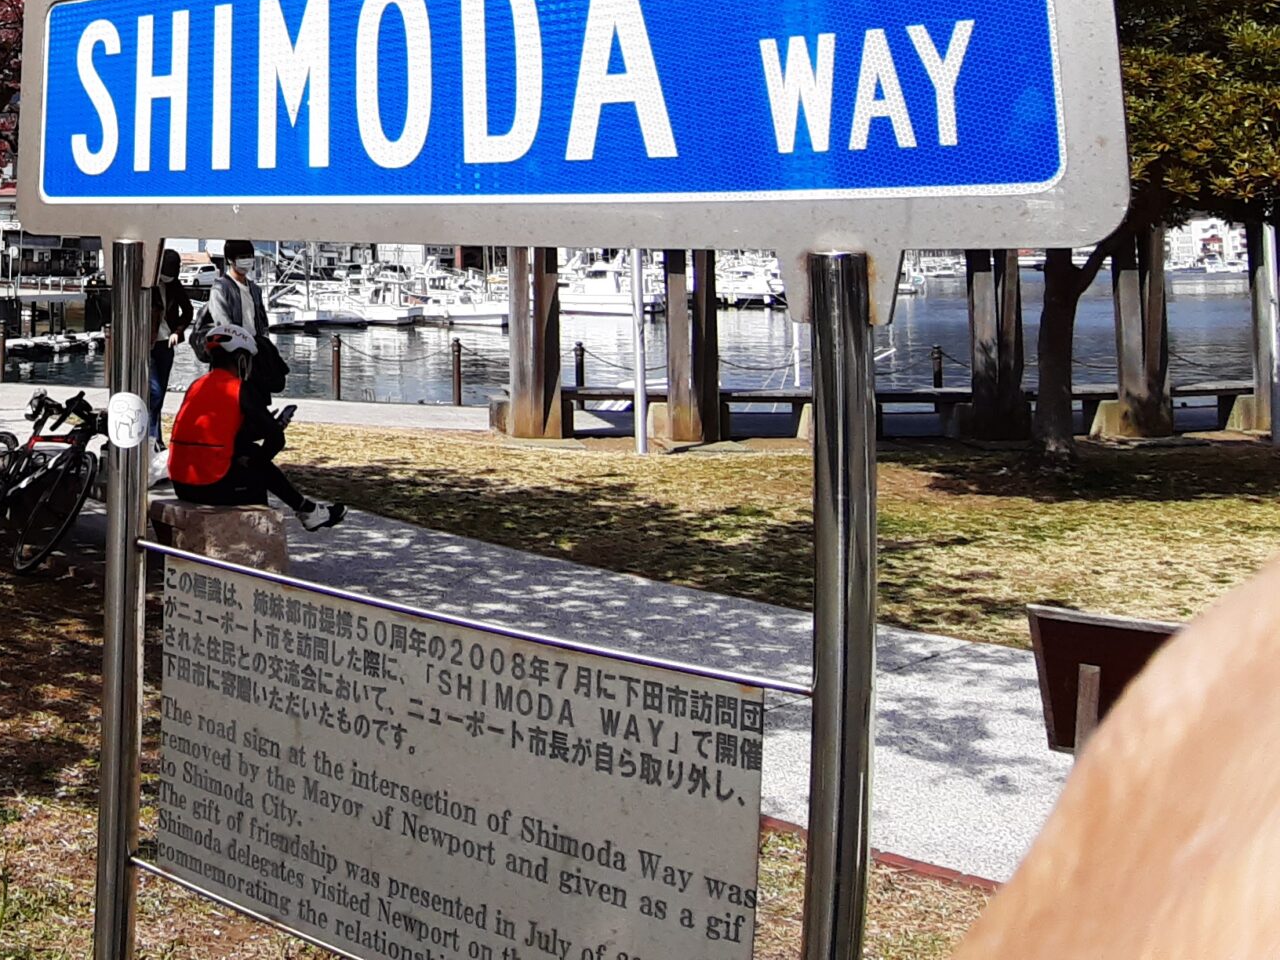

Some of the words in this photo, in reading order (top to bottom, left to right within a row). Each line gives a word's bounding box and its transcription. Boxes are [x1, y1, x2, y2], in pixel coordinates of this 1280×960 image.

[761, 20, 975, 154] WAY
[160, 753, 176, 778] to
[182, 760, 254, 809] Shimoda
[262, 792, 302, 827] City.
[161, 730, 231, 771] removed
[238, 752, 260, 783] by
[267, 765, 296, 795] the
[302, 776, 364, 819] Mayor
[372, 805, 394, 830] of
[401, 810, 496, 866] Newport
[506, 851, 549, 884] and
[559, 867, 627, 909] given
[639, 895, 668, 920] as
[679, 907, 695, 929] a
[163, 695, 192, 726] The
[197, 715, 237, 744] road
[243, 728, 281, 759] sign
[288, 745, 307, 768] at
[313, 752, 344, 781] the
[351, 761, 477, 826] intersection
[487, 809, 512, 836] of
[521, 816, 627, 872] Shimoda
[638, 849, 694, 893] Way
[704, 875, 758, 909] was
[157, 842, 291, 916] commemorating
[297, 892, 327, 929] the
[158, 808, 222, 854] Shimoda
[227, 839, 305, 888] delegates
[311, 875, 370, 917] visited
[377, 897, 460, 953] Newport
[468, 941, 492, 960] on
[159, 778, 187, 810] The
[192, 792, 222, 825] gift
[227, 811, 244, 834] of
[249, 816, 338, 875] friendship
[345, 859, 380, 889] was
[388, 877, 487, 930] presented
[495, 909, 517, 941] in
[525, 920, 572, 960] July
